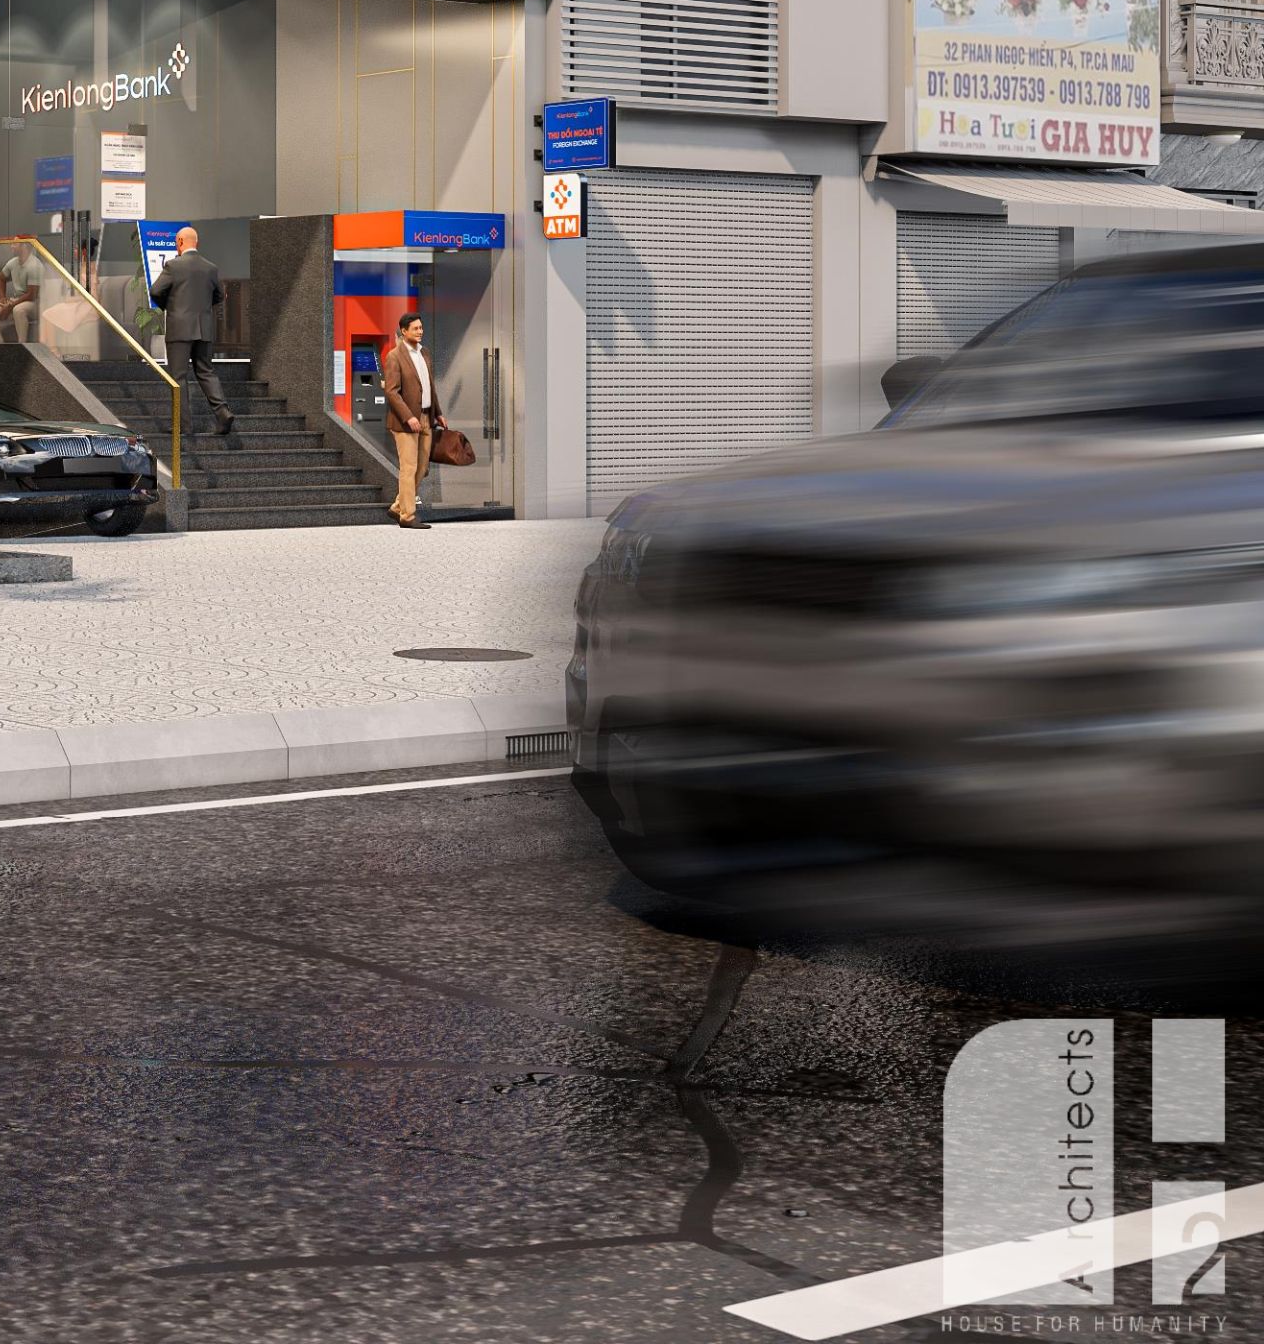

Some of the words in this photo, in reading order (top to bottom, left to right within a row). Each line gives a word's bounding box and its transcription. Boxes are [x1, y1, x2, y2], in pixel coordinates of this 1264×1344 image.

[944, 43, 958, 62] 32
[961, 43, 993, 64] PHAN
[995, 45, 1025, 70] NGỌC
[1111, 52, 1135, 73] MAU
[22, 67, 171, 114] KienlongBank
[927, 71, 949, 98] ĐT:
[953, 73, 1045, 103] 0913.397539
[1059, 79, 1122, 108] 0913.788
[1126, 85, 1151, 110] 798
[1040, 118, 1090, 155] GIA
[1098, 123, 1154, 158] HUY
[414, 231, 490, 247] KienlongBank
[546, 216, 577, 235] ATM
